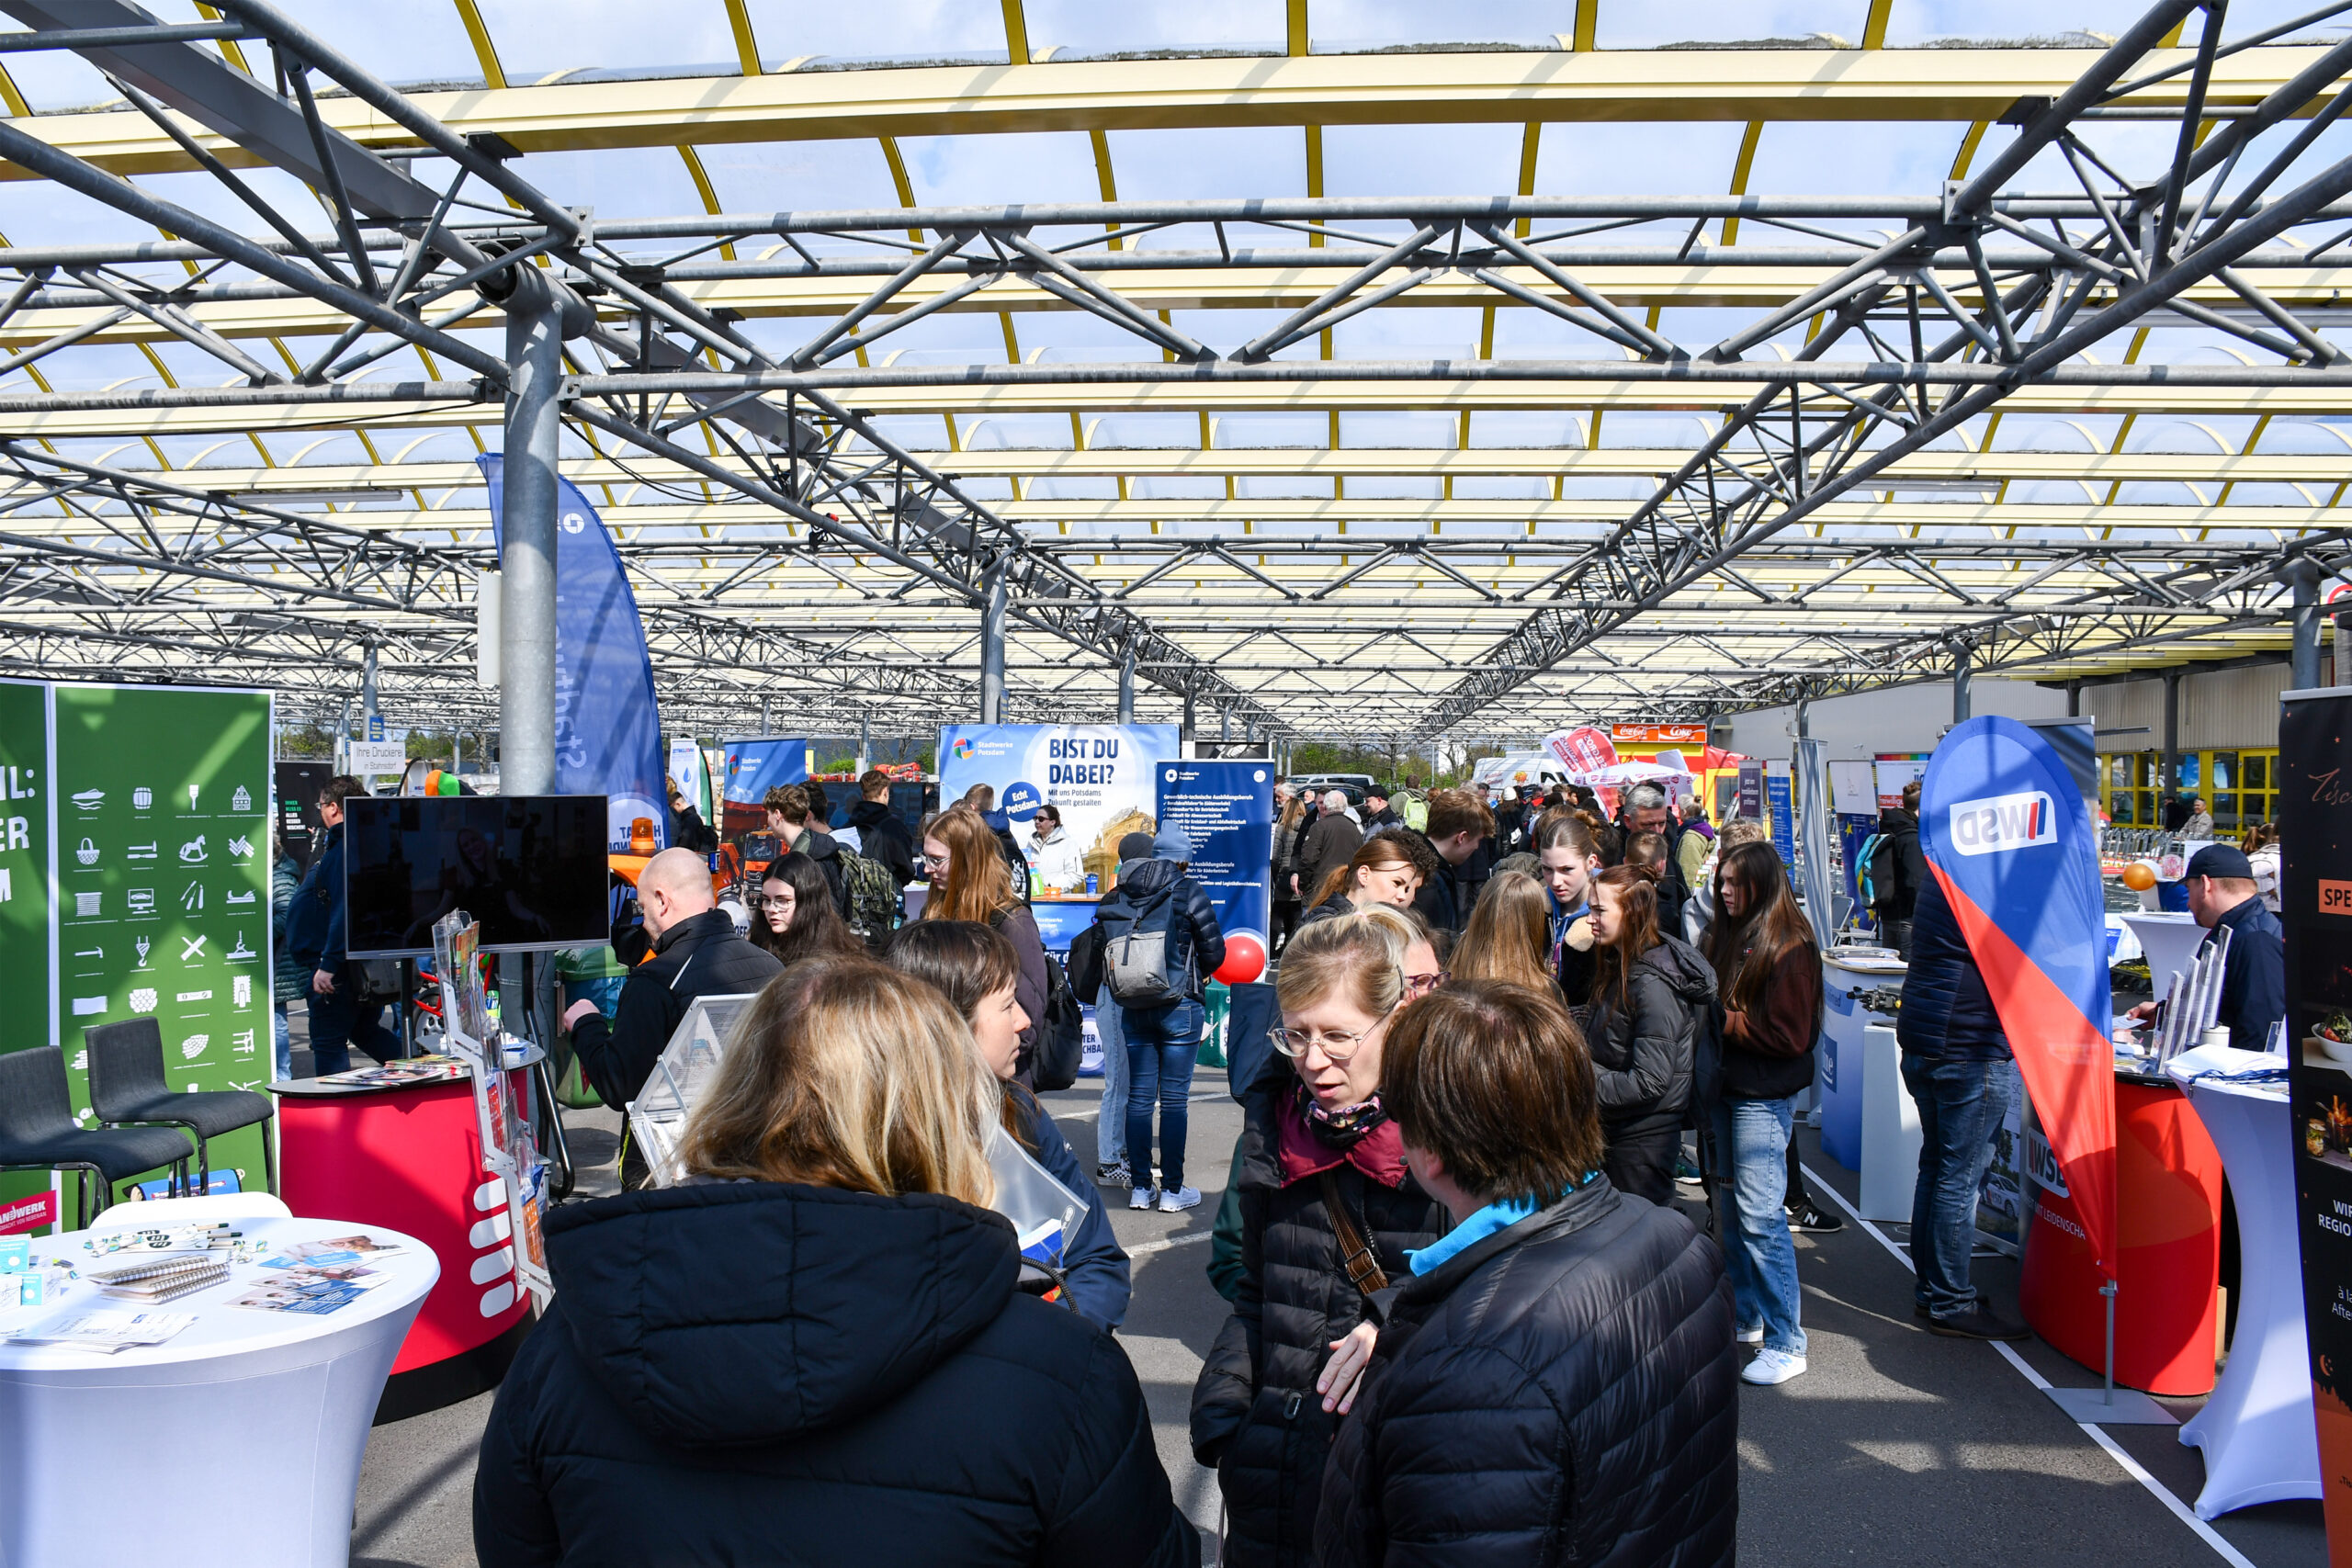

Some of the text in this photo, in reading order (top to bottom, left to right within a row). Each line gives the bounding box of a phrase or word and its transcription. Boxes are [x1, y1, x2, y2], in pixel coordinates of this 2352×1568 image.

[1669, 726, 1691, 737] Coke
[356, 746, 403, 757] Ihre Druckerei
[1049, 739, 1118, 759] BIST DU
[1049, 764, 1114, 784] DABEI?
[1012, 790, 1029, 802] Echt
[2308, 768, 2352, 805] Tisc
[1005, 798, 1040, 816] Potsdam.
[1048, 798, 1102, 807] Zukunft gestalten
[2043, 1208, 2086, 1240] LEIDENSCHA
[2318, 1213, 2352, 1236] REGIO
[2332, 1302, 2352, 1321] Afte
